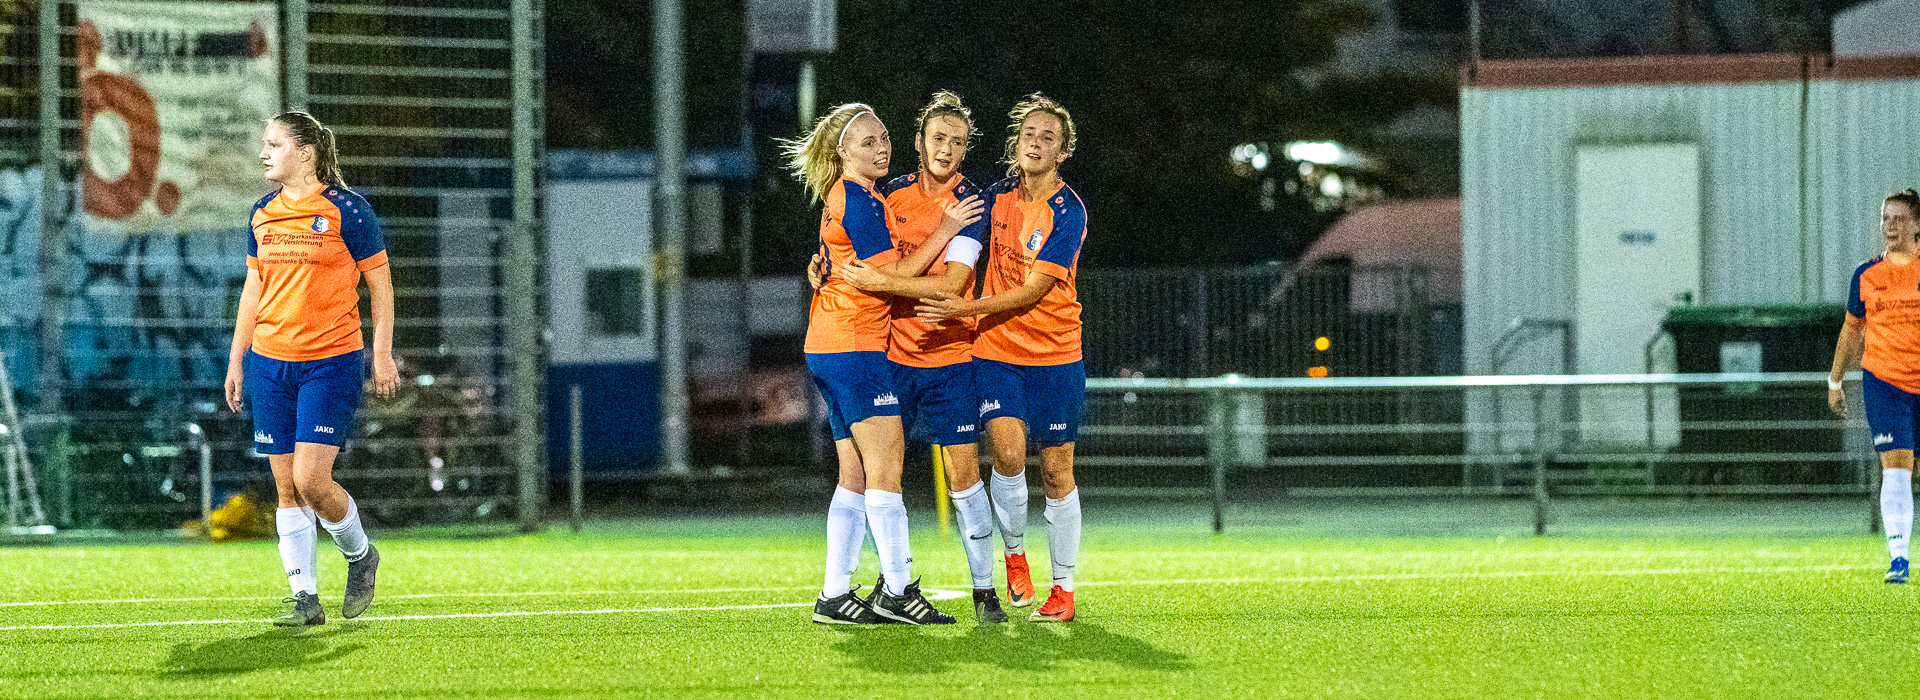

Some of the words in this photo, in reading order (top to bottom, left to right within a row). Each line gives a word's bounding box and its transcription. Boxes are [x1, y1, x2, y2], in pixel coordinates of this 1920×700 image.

[957, 424, 975, 433] JAKO
[1049, 423, 1067, 431] JAKO
[287, 568, 301, 577] AKO
